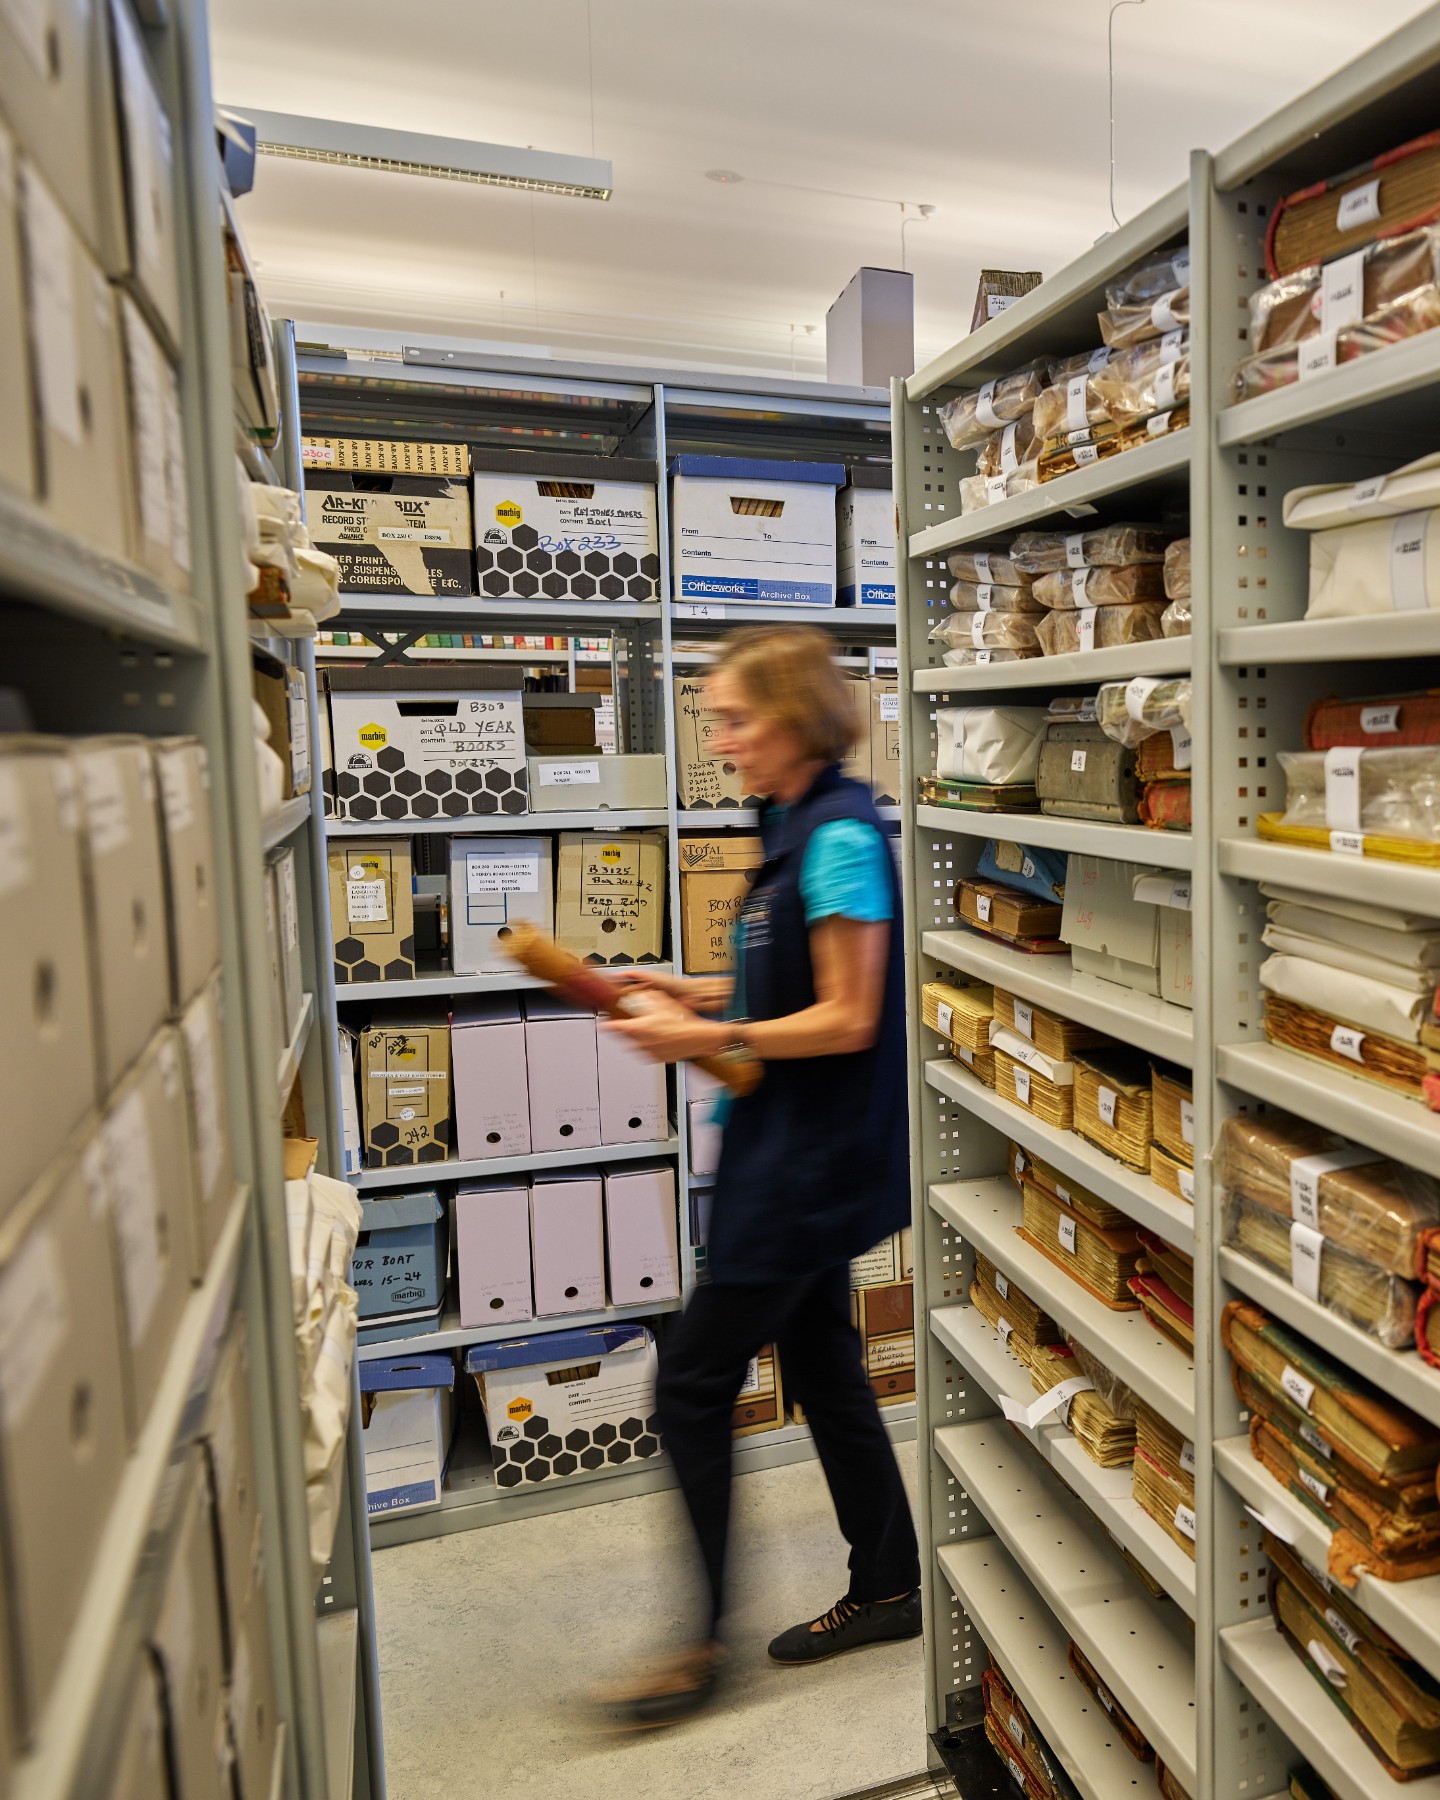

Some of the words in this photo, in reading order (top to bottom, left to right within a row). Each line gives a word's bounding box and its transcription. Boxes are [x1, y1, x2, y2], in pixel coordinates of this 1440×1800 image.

[498, 508, 520, 519] marbig
[322, 515, 354, 524] RECORD
[578, 536, 622, 550] 233
[333, 555, 352, 564] TER
[354, 566, 398, 576] SUSPENS
[428, 569, 442, 578] LES
[688, 582, 744, 593] Officeworks
[760, 590, 792, 600] Archive
[690, 606, 698, 616] T
[701, 606, 708, 615] 4
[475, 720, 515, 737] YEAR
[361, 732, 386, 742] marbig
[453, 741, 506, 752] BOOKS
[686, 843, 723, 855] TOTAL
[708, 898, 731, 912] BOX
[405, 1125, 429, 1145] 242
[352, 1260, 374, 1270] TOR
[382, 1254, 415, 1266] BOAT
[394, 1290, 422, 1300] marbig
[878, 1352, 905, 1362] PHOTOS
[568, 1398, 591, 1406] CONTENTS
[509, 1403, 532, 1414] marbig
[368, 1502, 388, 1511] hive
[391, 1497, 410, 1506] Box
